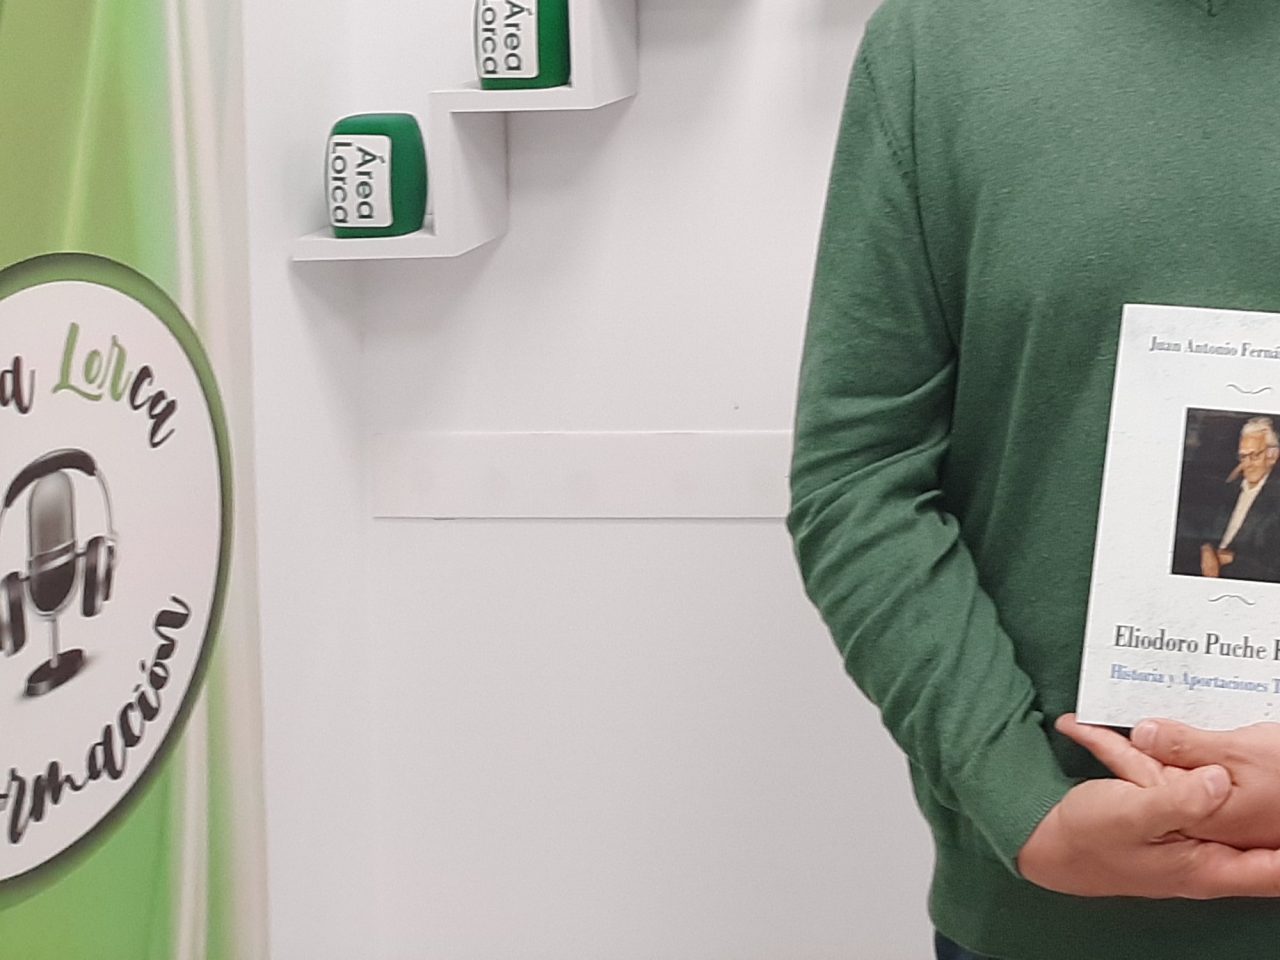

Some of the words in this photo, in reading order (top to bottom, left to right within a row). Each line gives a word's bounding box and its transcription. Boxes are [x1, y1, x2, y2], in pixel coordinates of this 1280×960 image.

[504, 0, 532, 72] Área
[331, 142, 353, 225] Lorca
[356, 146, 386, 220] Área
[1149, 335, 1182, 352] Juan
[1185, 338, 1239, 357] Antonio
[52, 321, 178, 449] Lorca
[1109, 663, 1165, 684] Historia
[1179, 671, 1268, 692] Aportaciones
[1113, 624, 1199, 654] Eliodoro
[1204, 632, 1267, 660] Puche
[0, 594, 190, 844] rmación
